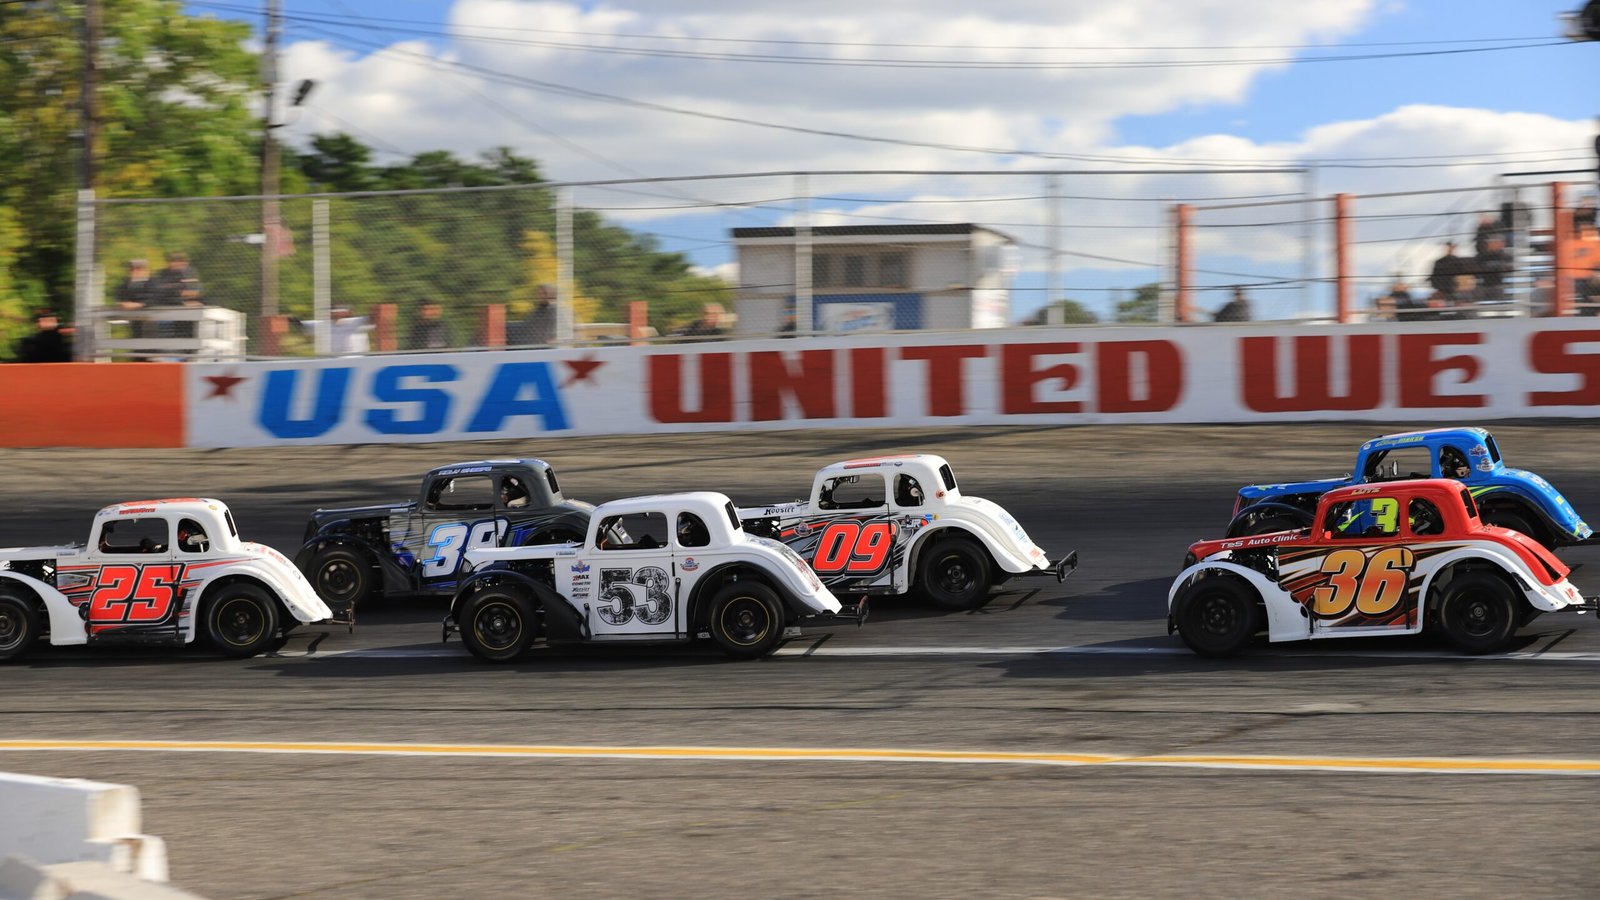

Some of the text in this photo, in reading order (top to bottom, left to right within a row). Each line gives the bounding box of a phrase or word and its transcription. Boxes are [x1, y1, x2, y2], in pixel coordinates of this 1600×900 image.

[257, 361, 573, 439] USA
[647, 339, 1185, 424] UNITED
[812, 522, 898, 572] 09
[1247, 538, 1270, 546] Auto
[1272, 534, 1298, 543] Clinic
[88, 564, 183, 623] 25
[597, 566, 673, 626] 53
[1312, 548, 1415, 616] 36
